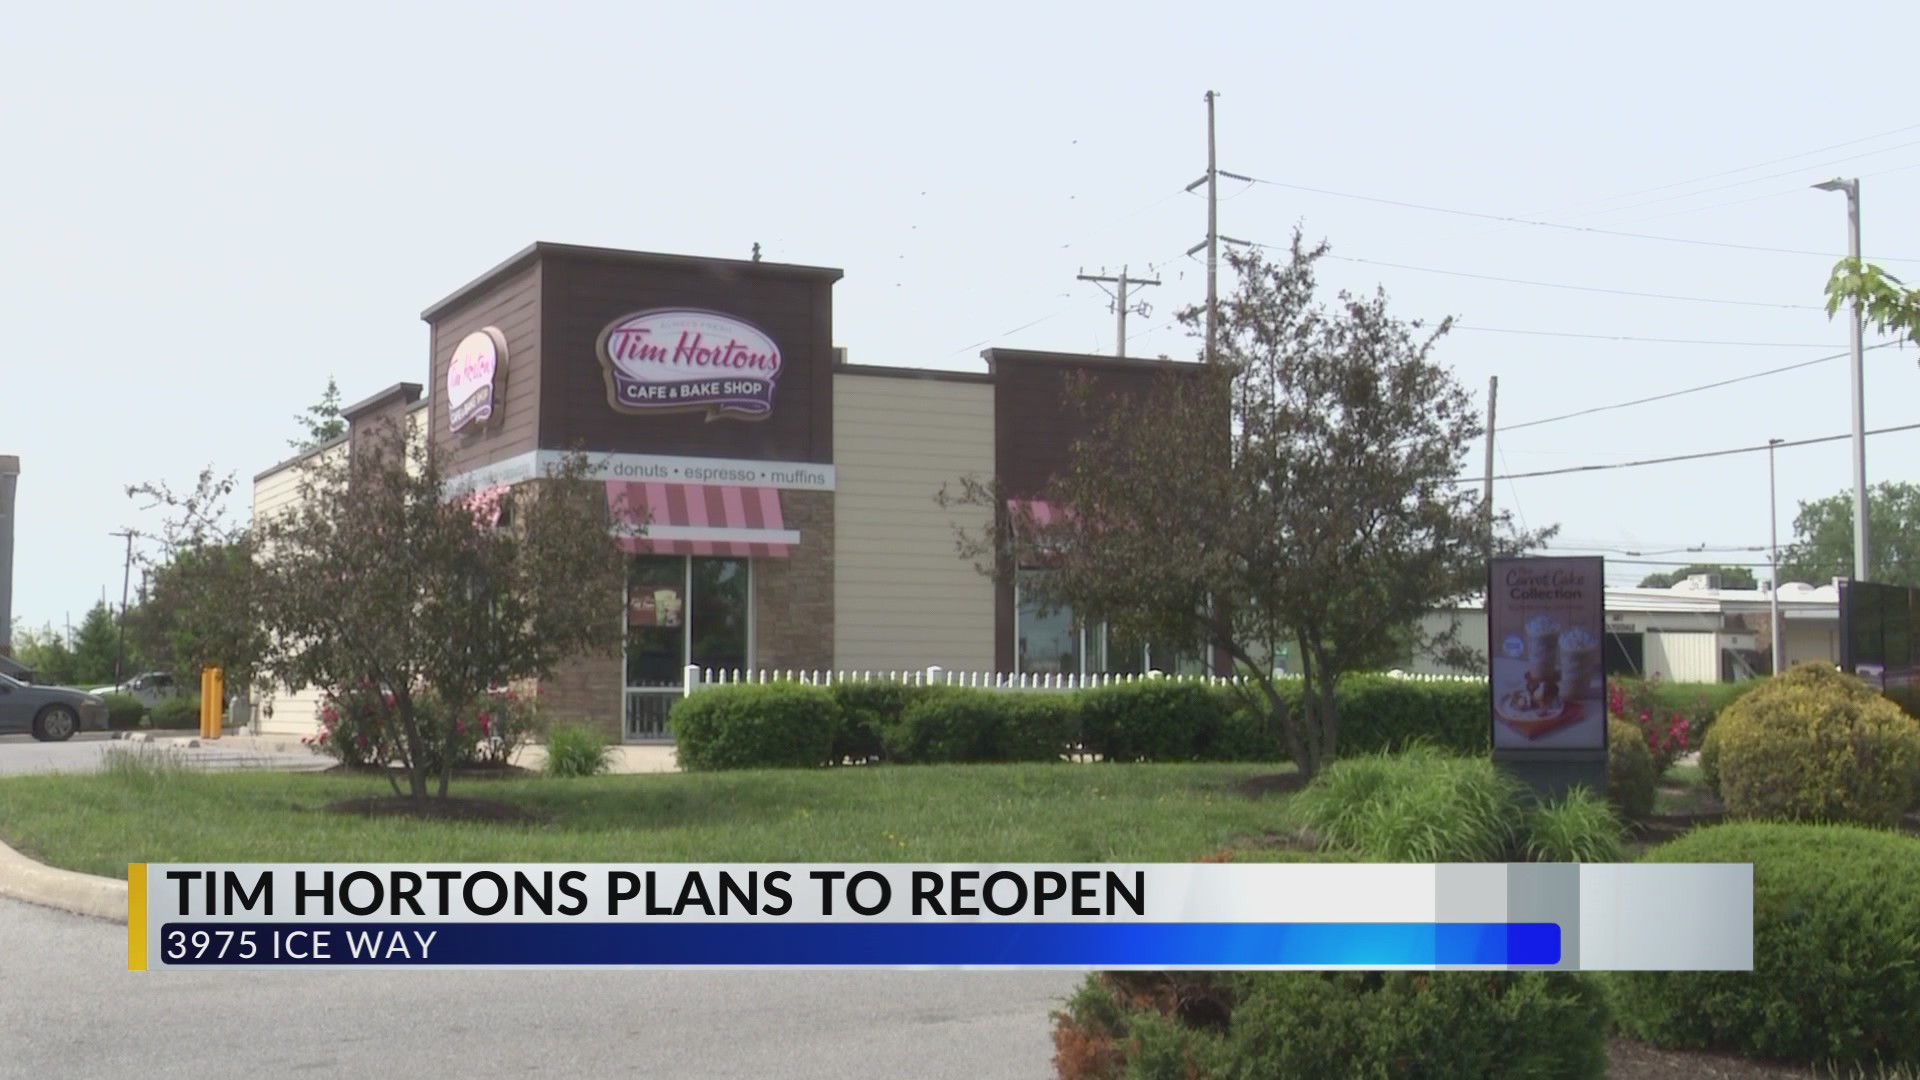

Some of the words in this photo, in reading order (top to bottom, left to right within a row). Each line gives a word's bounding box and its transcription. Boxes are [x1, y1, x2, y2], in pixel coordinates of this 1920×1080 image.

[614, 328, 667, 361] Tim
[672, 330, 778, 370] Hortons
[627, 385, 666, 400] CAFE
[669, 387, 677, 398] &
[680, 382, 720, 398] BAKE
[724, 381, 762, 395] SHOP
[613, 461, 668, 477] donuts
[684, 466, 756, 481] espresso
[770, 469, 825, 485] muffins
[1506, 568, 1549, 587] Carrot
[1552, 568, 1584, 587] Cake
[1510, 587, 1582, 600] Collection
